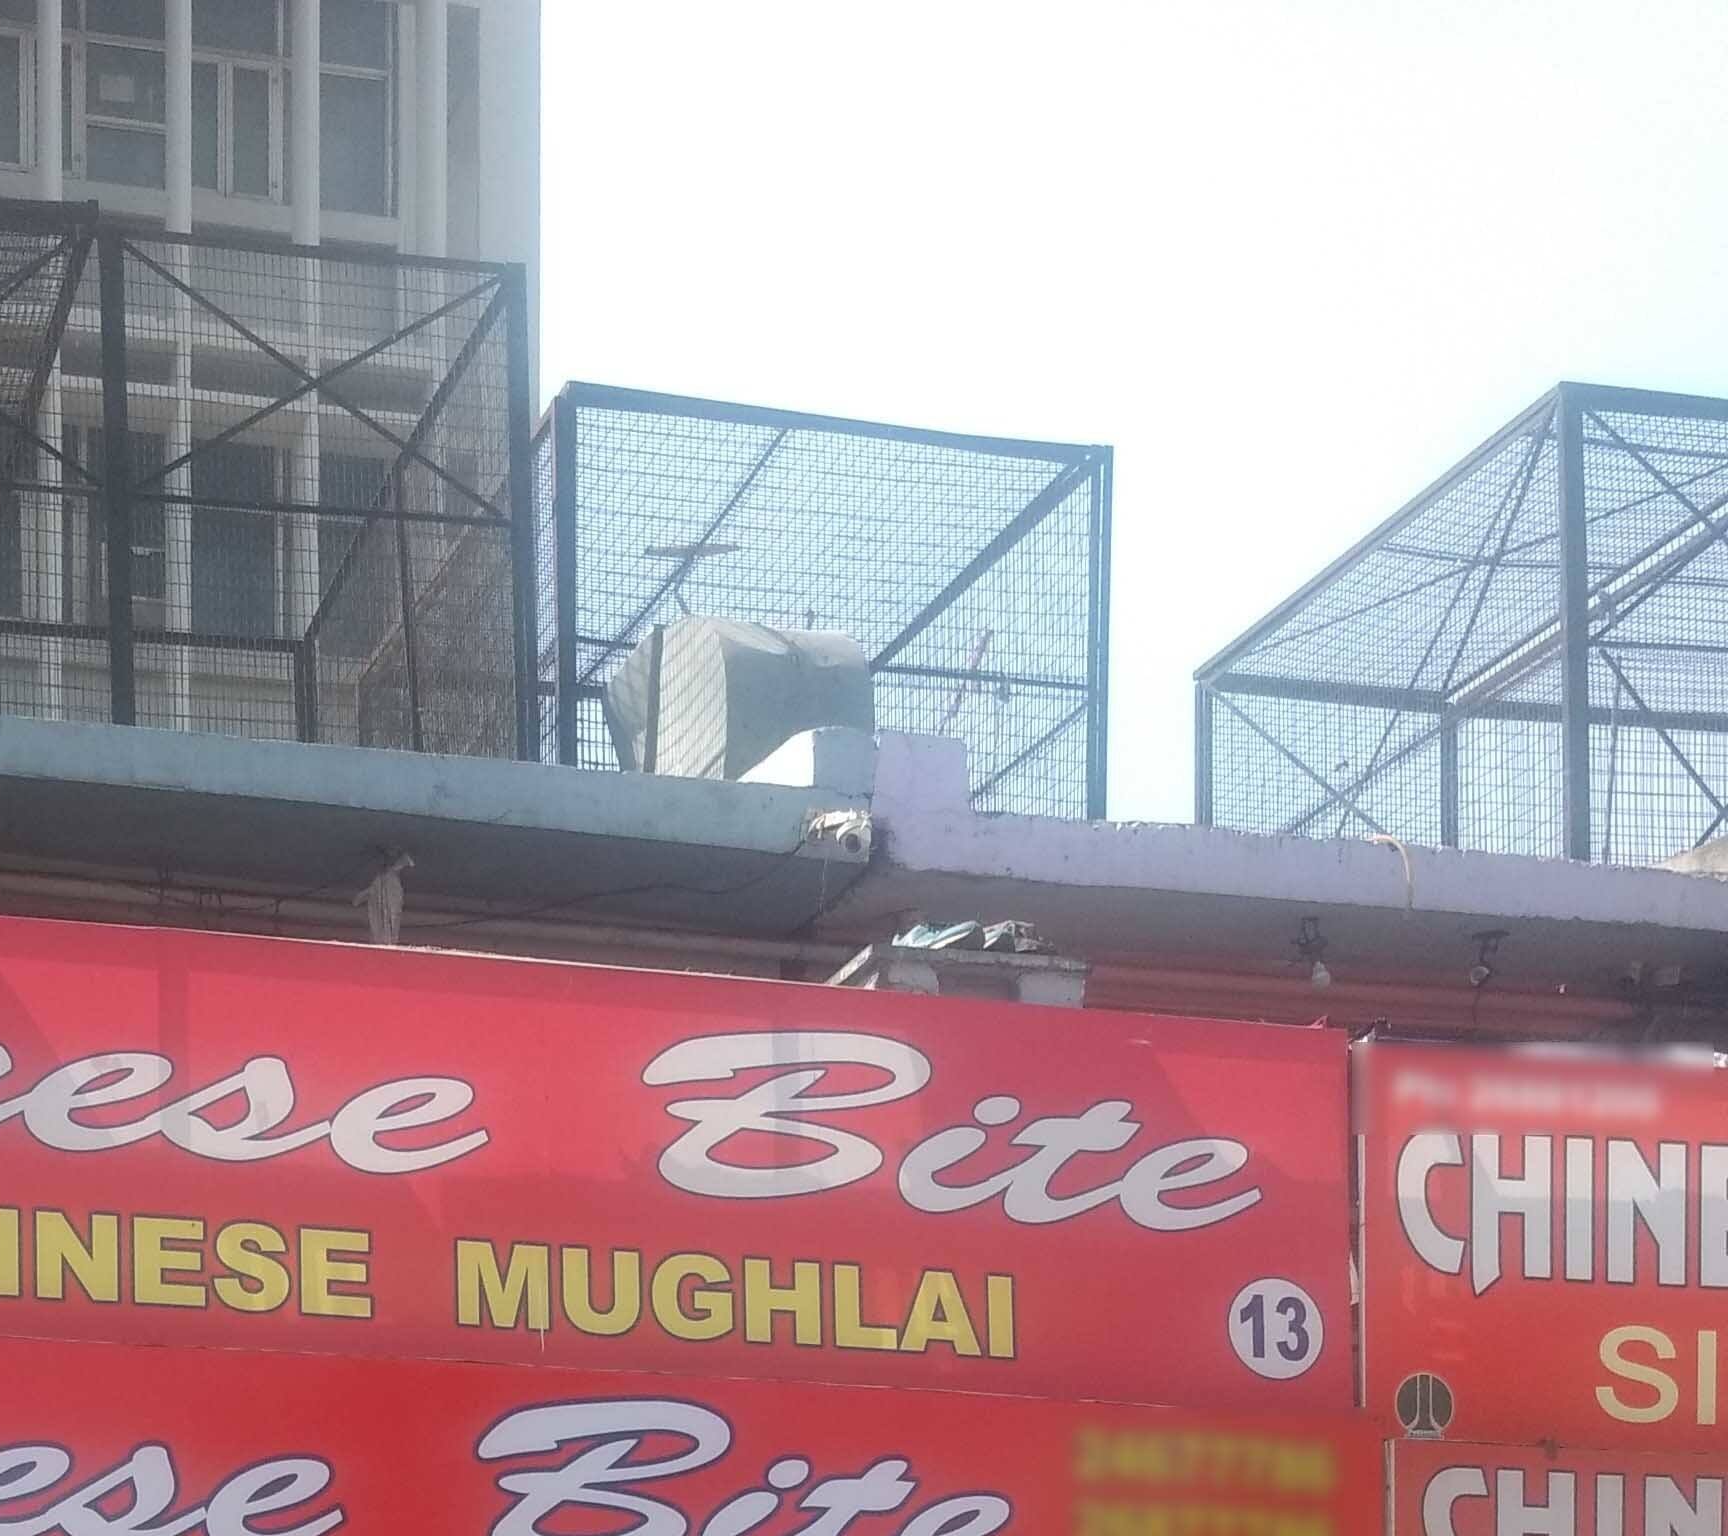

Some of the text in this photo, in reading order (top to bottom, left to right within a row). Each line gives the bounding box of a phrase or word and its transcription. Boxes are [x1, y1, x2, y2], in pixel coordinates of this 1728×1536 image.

[642, 1031, 1262, 1232] Bite
[456, 1239, 1016, 1360] MUGHLAI
[1238, 1294, 1310, 1362] 13
[1595, 1325, 1718, 1426] SI
